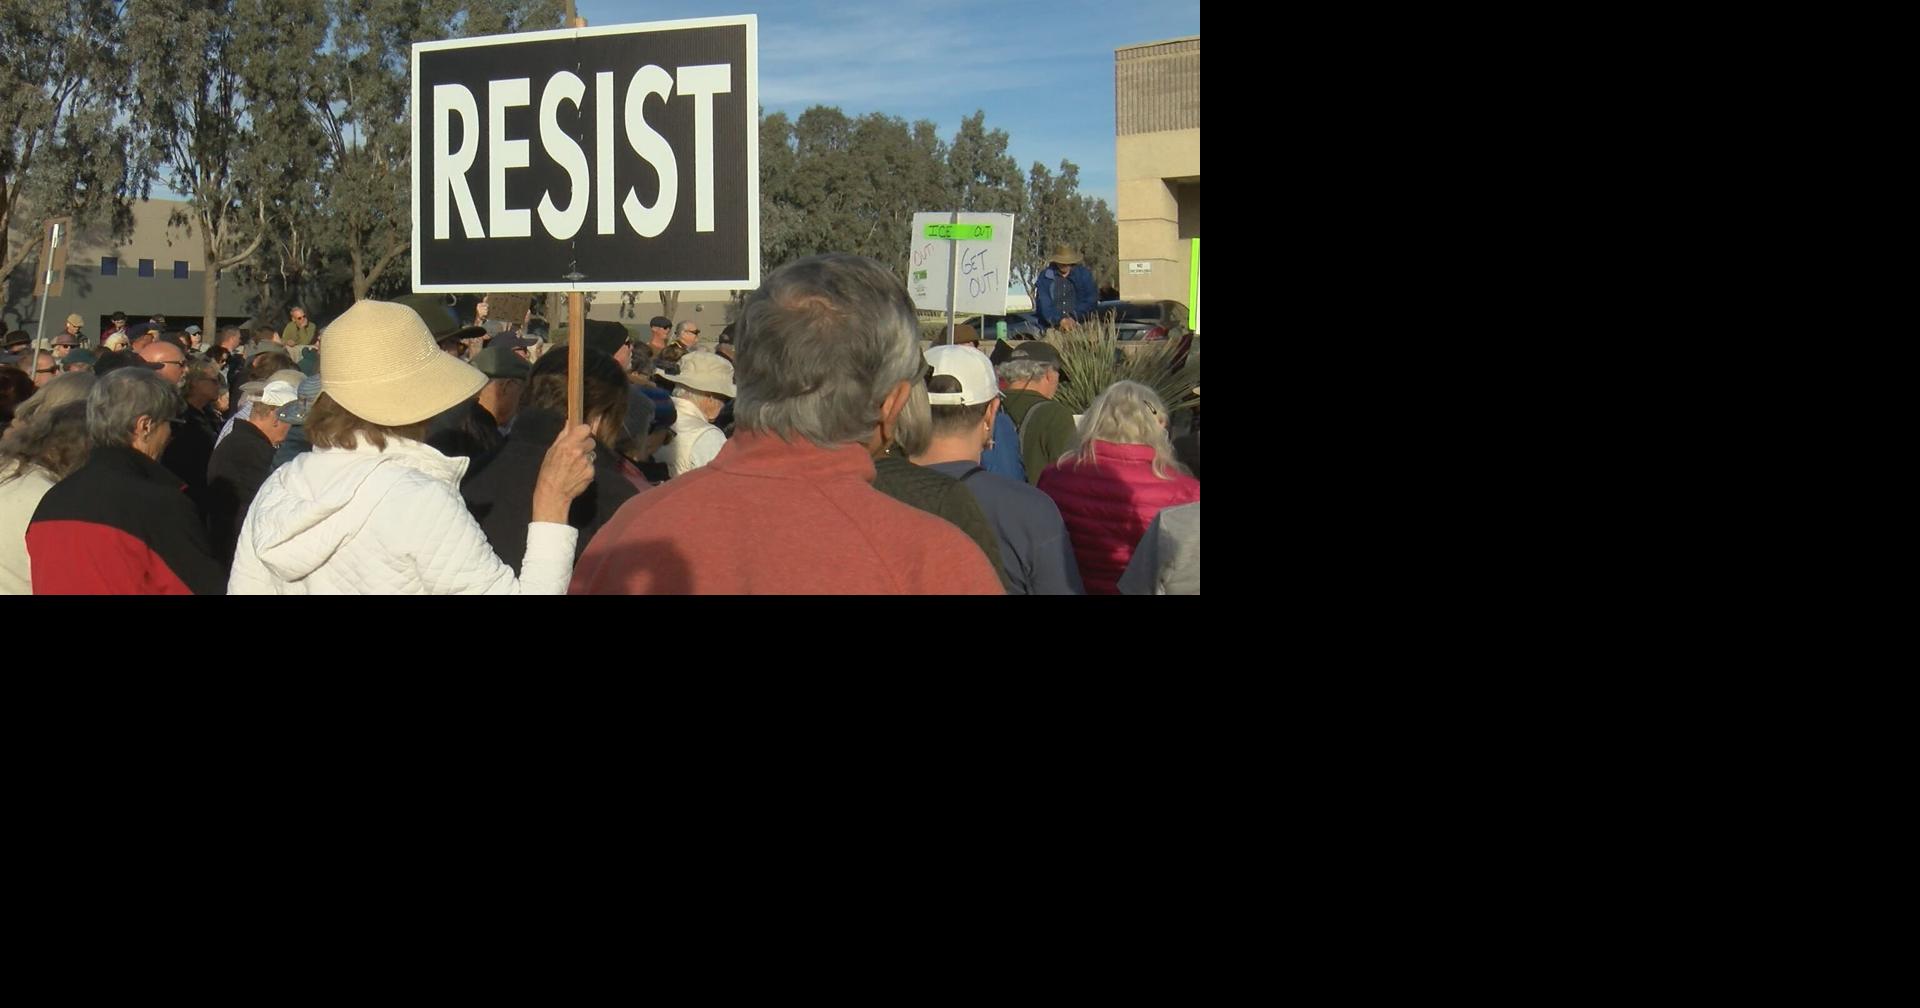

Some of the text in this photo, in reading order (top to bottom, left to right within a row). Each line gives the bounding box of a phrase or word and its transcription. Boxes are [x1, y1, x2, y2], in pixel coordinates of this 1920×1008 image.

[433, 63, 731, 240] RESIST
[928, 225, 953, 238] ICE
[961, 247, 988, 275] GET
[969, 267, 999, 298] OUT!
